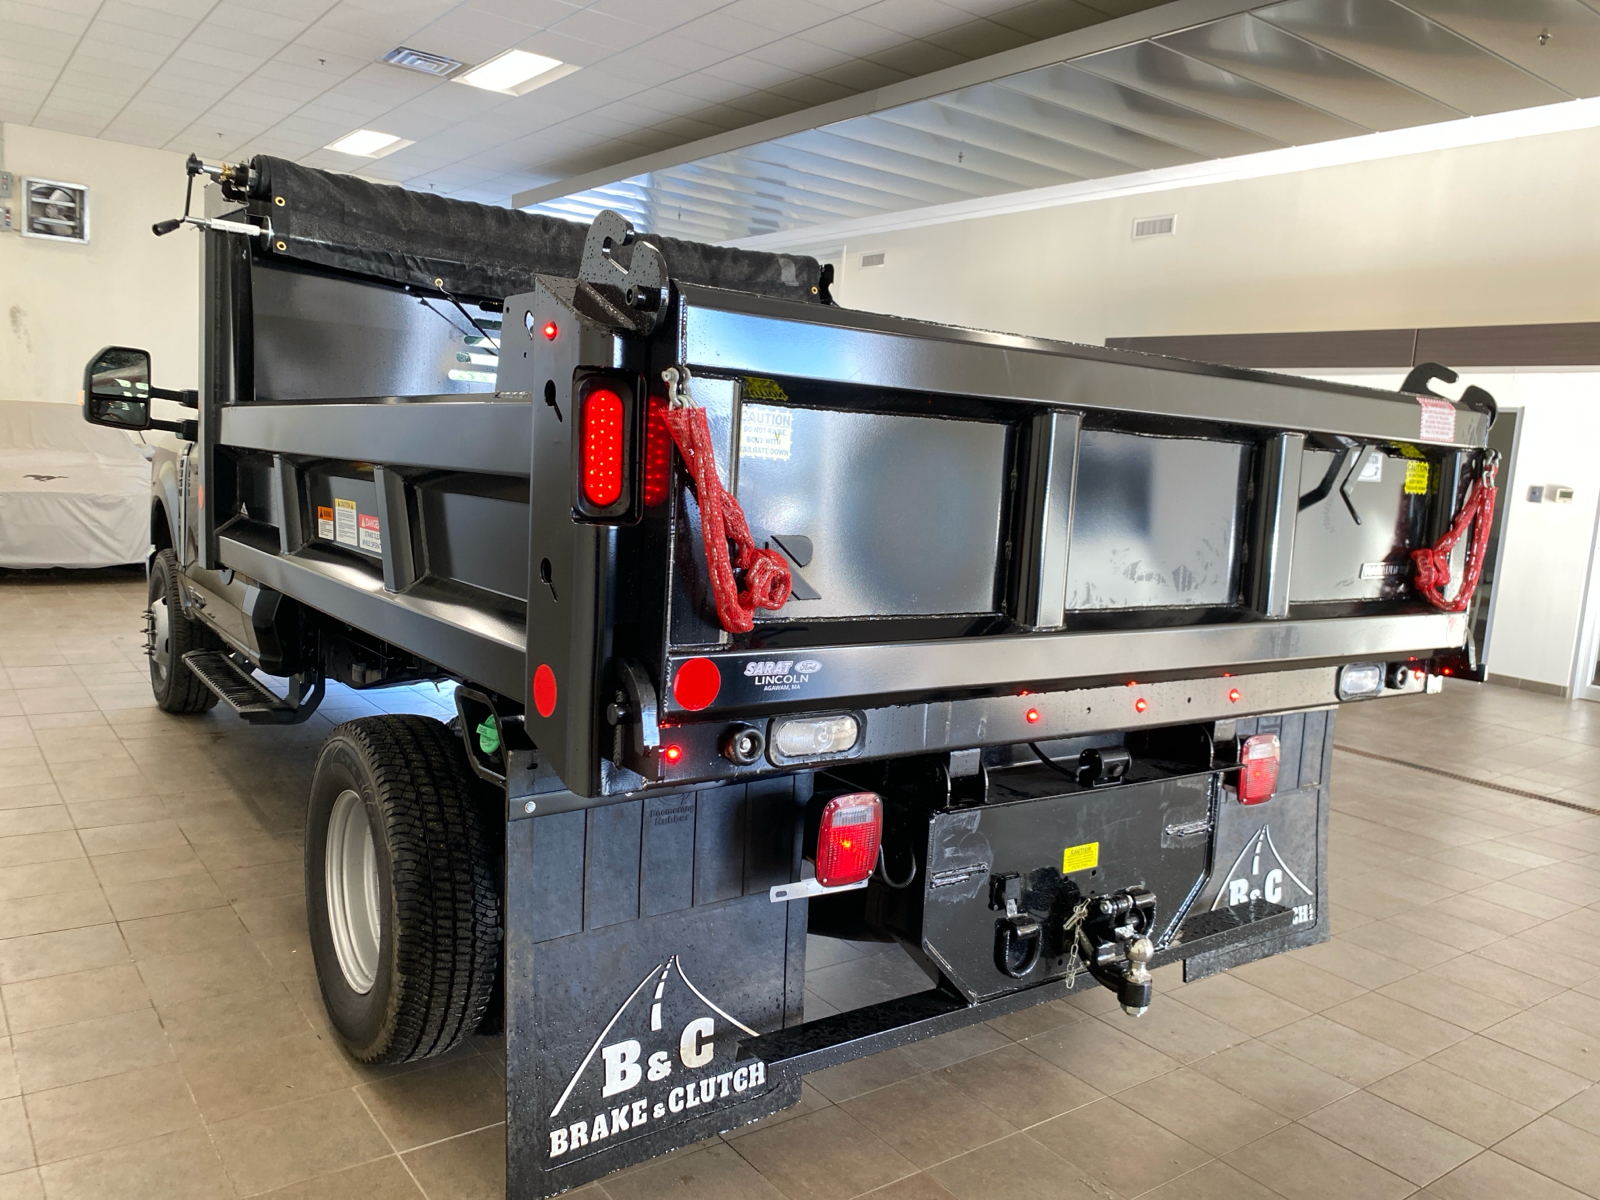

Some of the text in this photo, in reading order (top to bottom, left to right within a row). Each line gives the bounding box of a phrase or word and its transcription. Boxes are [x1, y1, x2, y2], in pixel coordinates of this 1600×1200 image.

[754, 426, 767, 434] NOT
[770, 447, 789, 456] DOWN
[744, 660, 794, 676] SARAT
[755, 674, 809, 685] LINCOLN
[549, 1099, 648, 1158] BRAKE
[668, 1061, 765, 1113] CLUTCH
